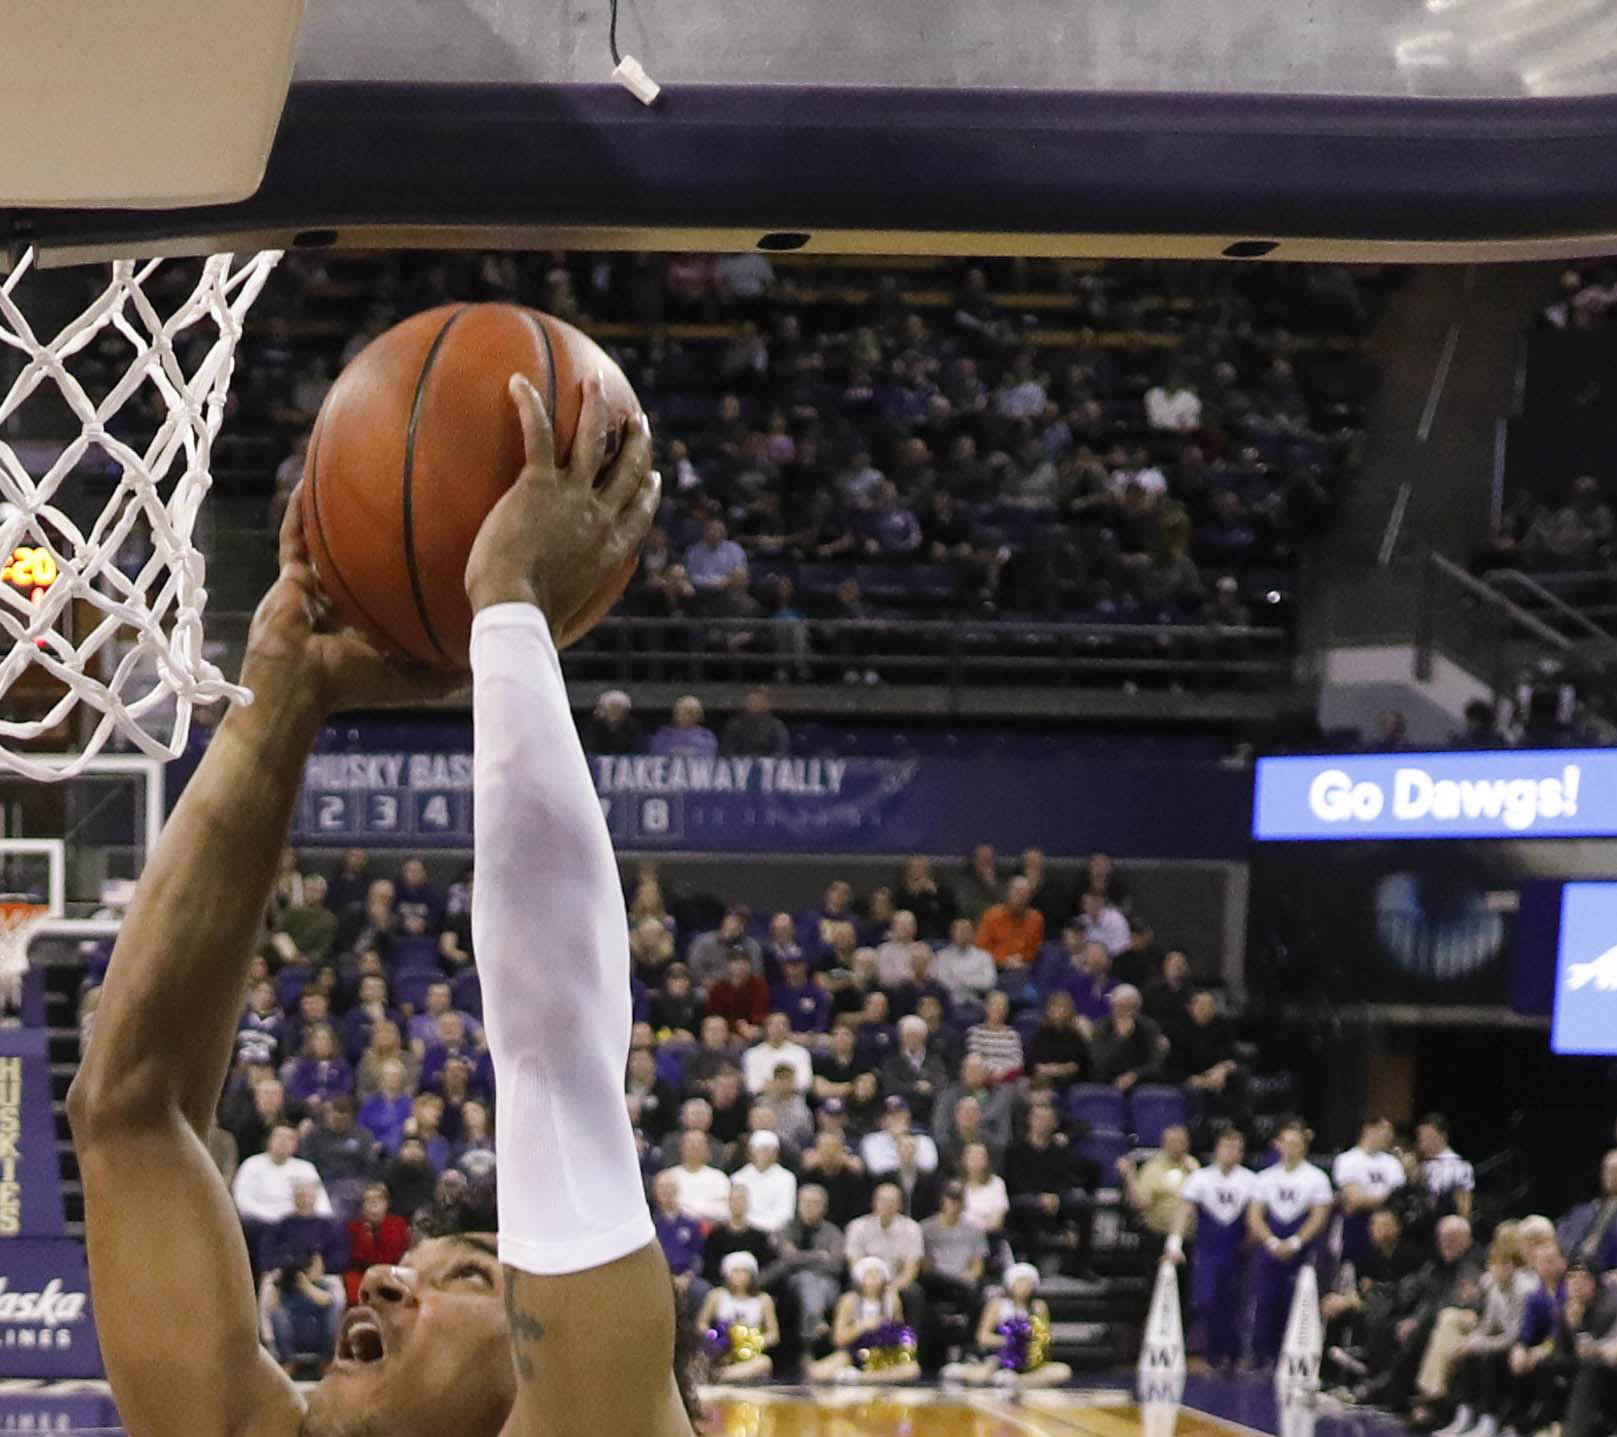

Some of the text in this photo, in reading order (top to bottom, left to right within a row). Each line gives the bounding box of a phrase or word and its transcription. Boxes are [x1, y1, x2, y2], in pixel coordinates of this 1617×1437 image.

[594, 756, 753, 791] TAKEAWAY
[759, 756, 846, 794] TALLY
[319, 795, 345, 828] 2
[369, 795, 398, 829] 3
[422, 795, 449, 827] 4
[1309, 766, 1579, 829] Go Dawgs!
